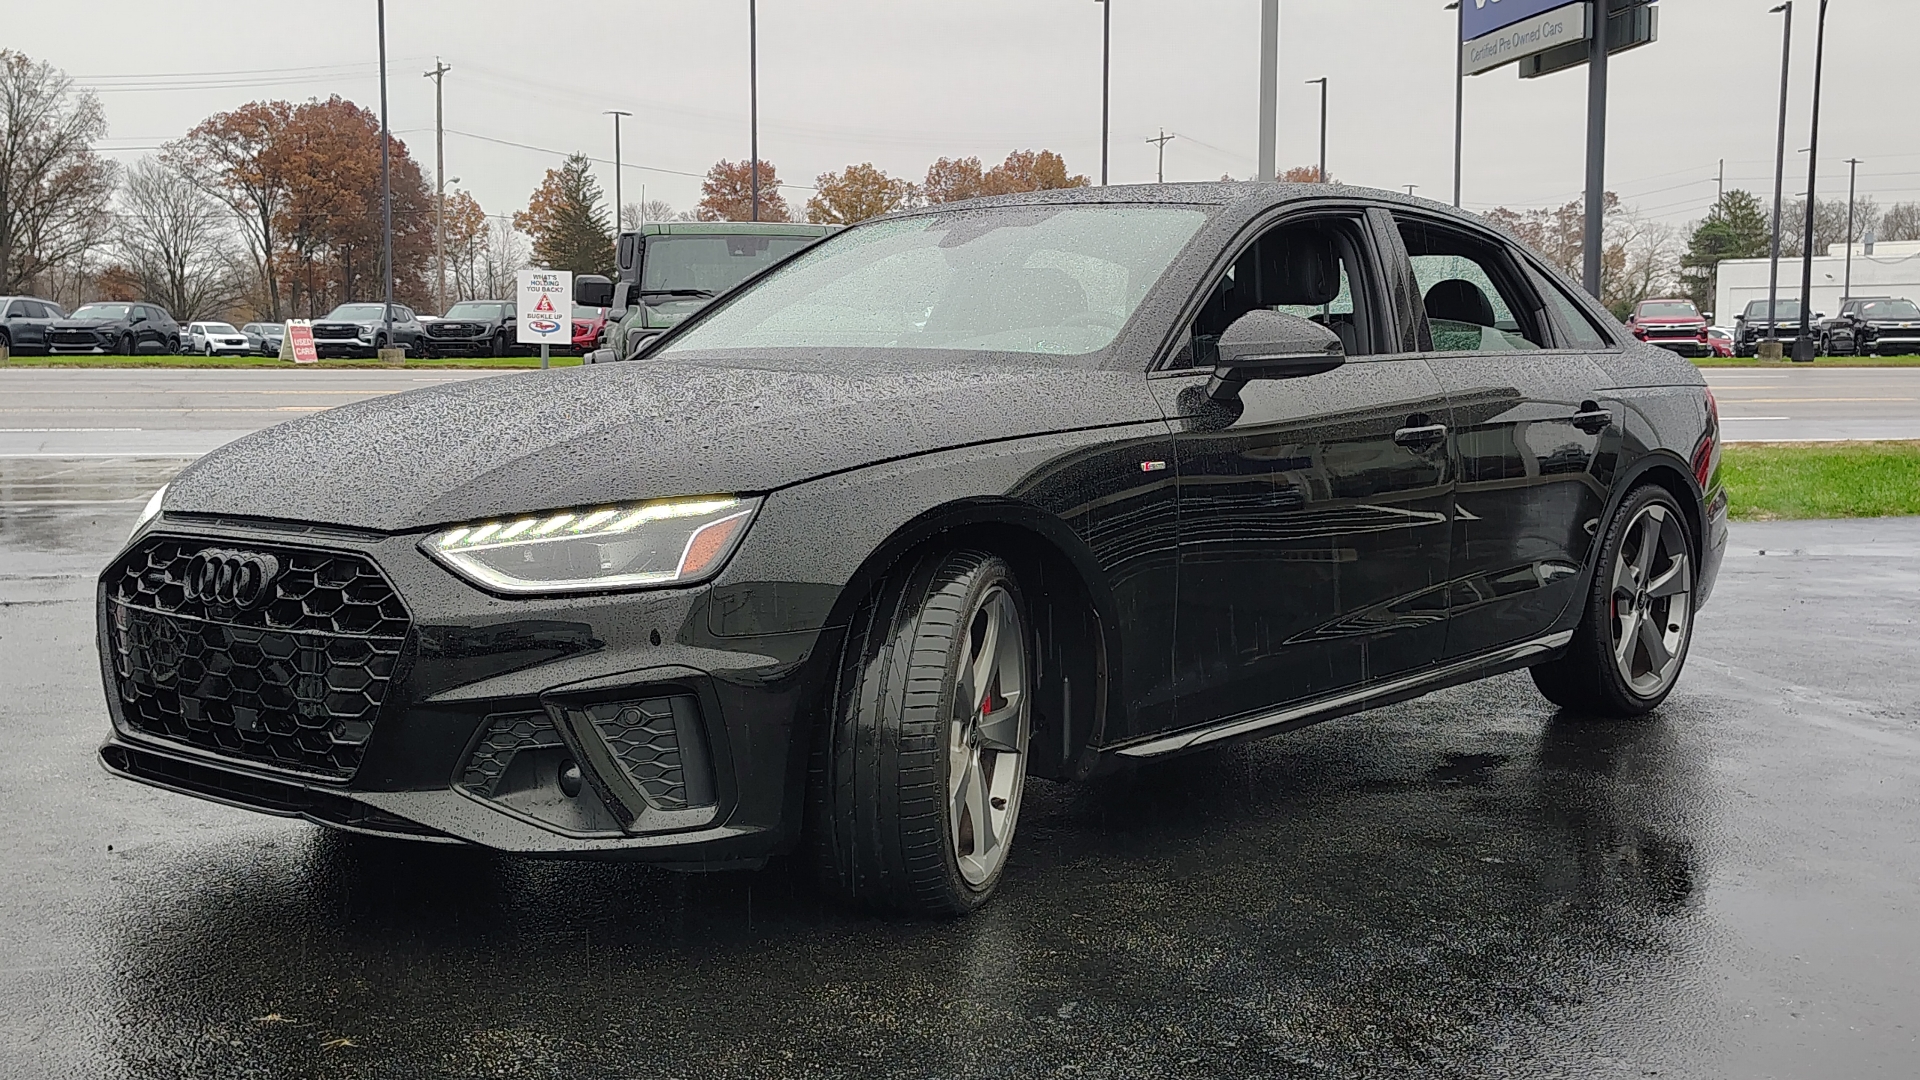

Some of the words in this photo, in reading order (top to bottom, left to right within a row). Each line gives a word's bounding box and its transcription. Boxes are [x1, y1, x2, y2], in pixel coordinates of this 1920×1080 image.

[1470, 40, 1498, 63] Certified
[1499, 37, 1511, 53] Pre
[1512, 25, 1541, 48] Owned
[1542, 21, 1563, 38] Cars
[294, 338, 312, 346] USED
[296, 347, 315, 356] CARS
